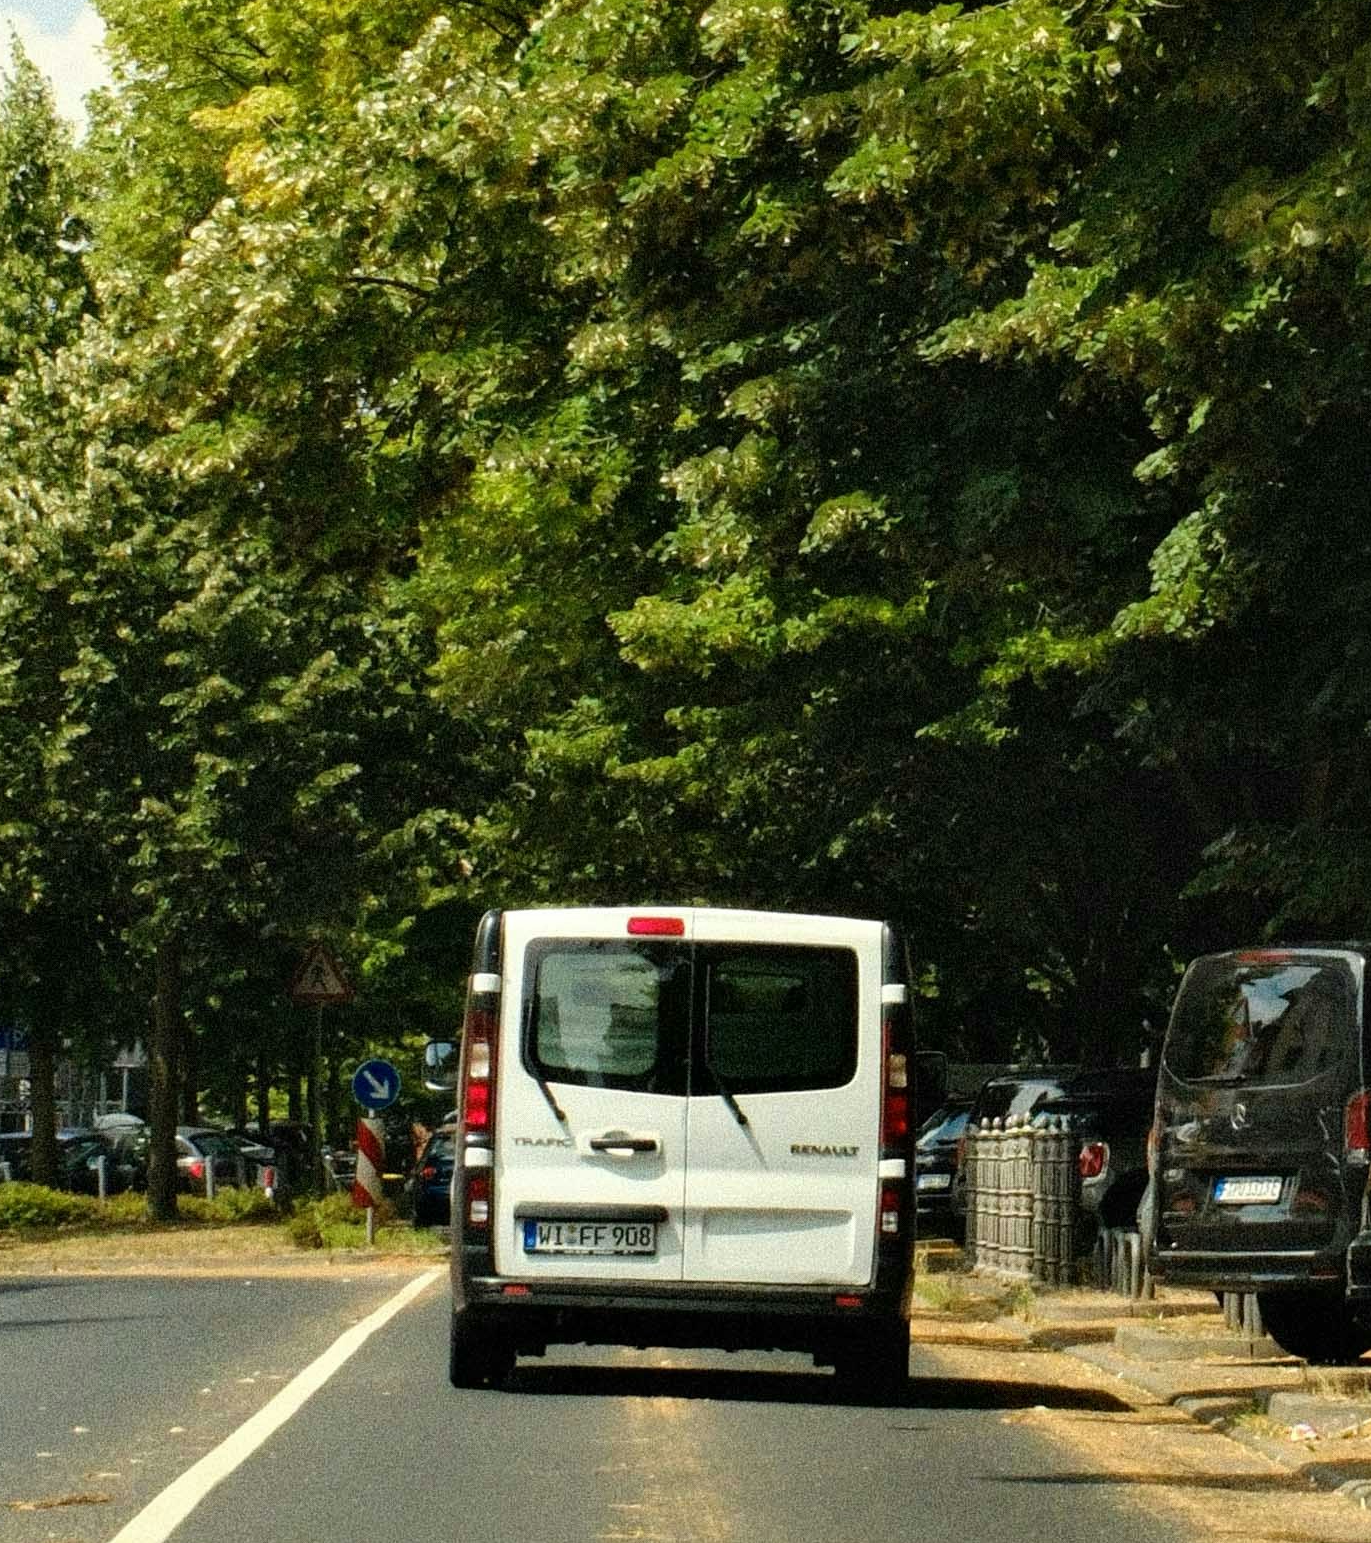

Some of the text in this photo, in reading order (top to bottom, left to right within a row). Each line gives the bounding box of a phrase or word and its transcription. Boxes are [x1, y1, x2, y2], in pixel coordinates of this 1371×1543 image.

[515, 1137, 574, 1148] TRAFIC
[790, 1144, 860, 1157] RENAULT
[538, 1225, 651, 1247] WI FF 908
